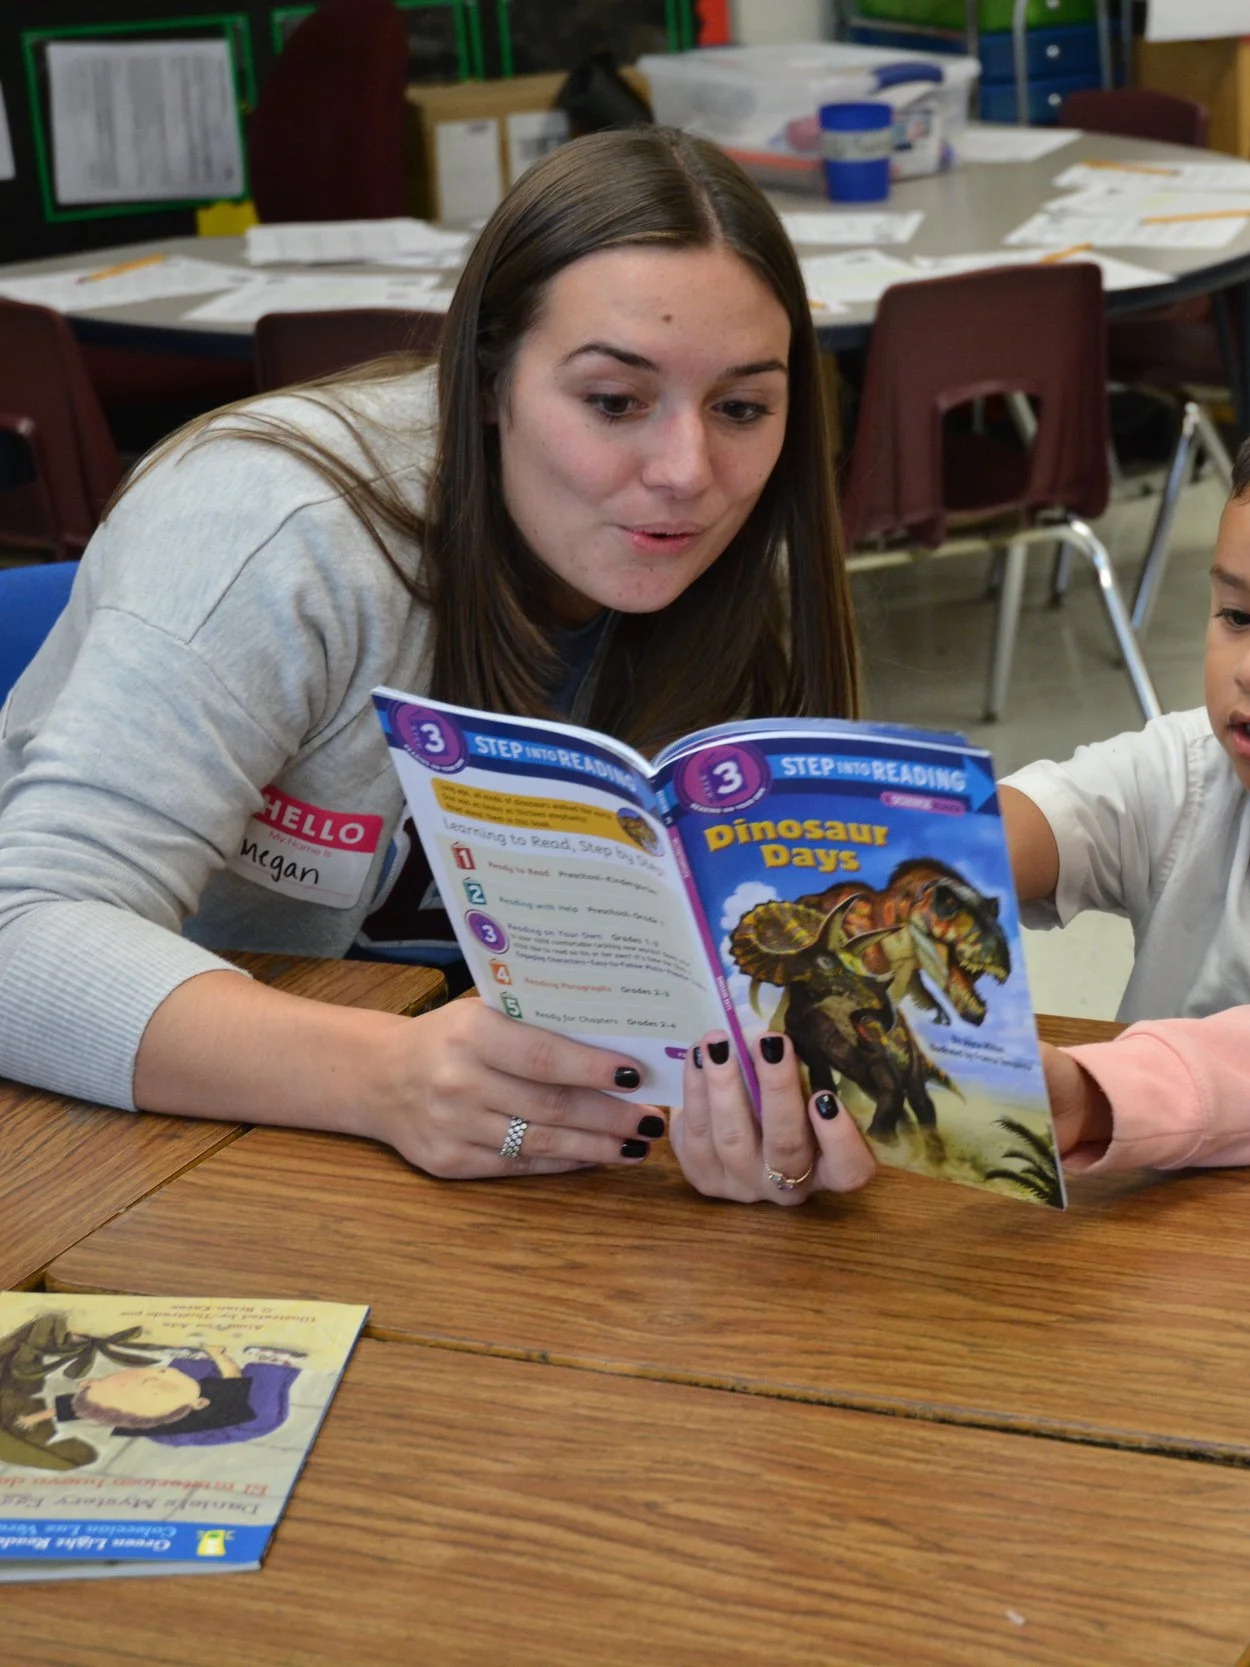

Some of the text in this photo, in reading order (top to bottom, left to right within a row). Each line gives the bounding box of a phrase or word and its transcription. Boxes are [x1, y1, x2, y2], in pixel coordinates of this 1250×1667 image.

[420, 722, 446, 753] 3
[474, 735, 523, 759] STEP
[525, 746, 557, 762] INTO
[558, 749, 638, 793] READING
[712, 760, 743, 795] 3
[780, 756, 967, 793] STEP INTO READING
[262, 797, 365, 845] HELLO
[704, 818, 889, 852] Dinosaur
[443, 816, 507, 847] Learning
[510, 834, 527, 847] to
[530, 835, 577, 853] Read,
[580, 840, 613, 859] Step
[615, 845, 634, 866] by
[760, 844, 860, 873] Days
[468, 884, 486, 904] 2
[480, 923, 498, 943] 3
[498, 967, 512, 984] 4
[507, 999, 520, 1018] 5
[53, 1494, 157, 1510] Mystery
[55, 1536, 108, 1552] Light
[111, 1537, 172, 1552] Green
